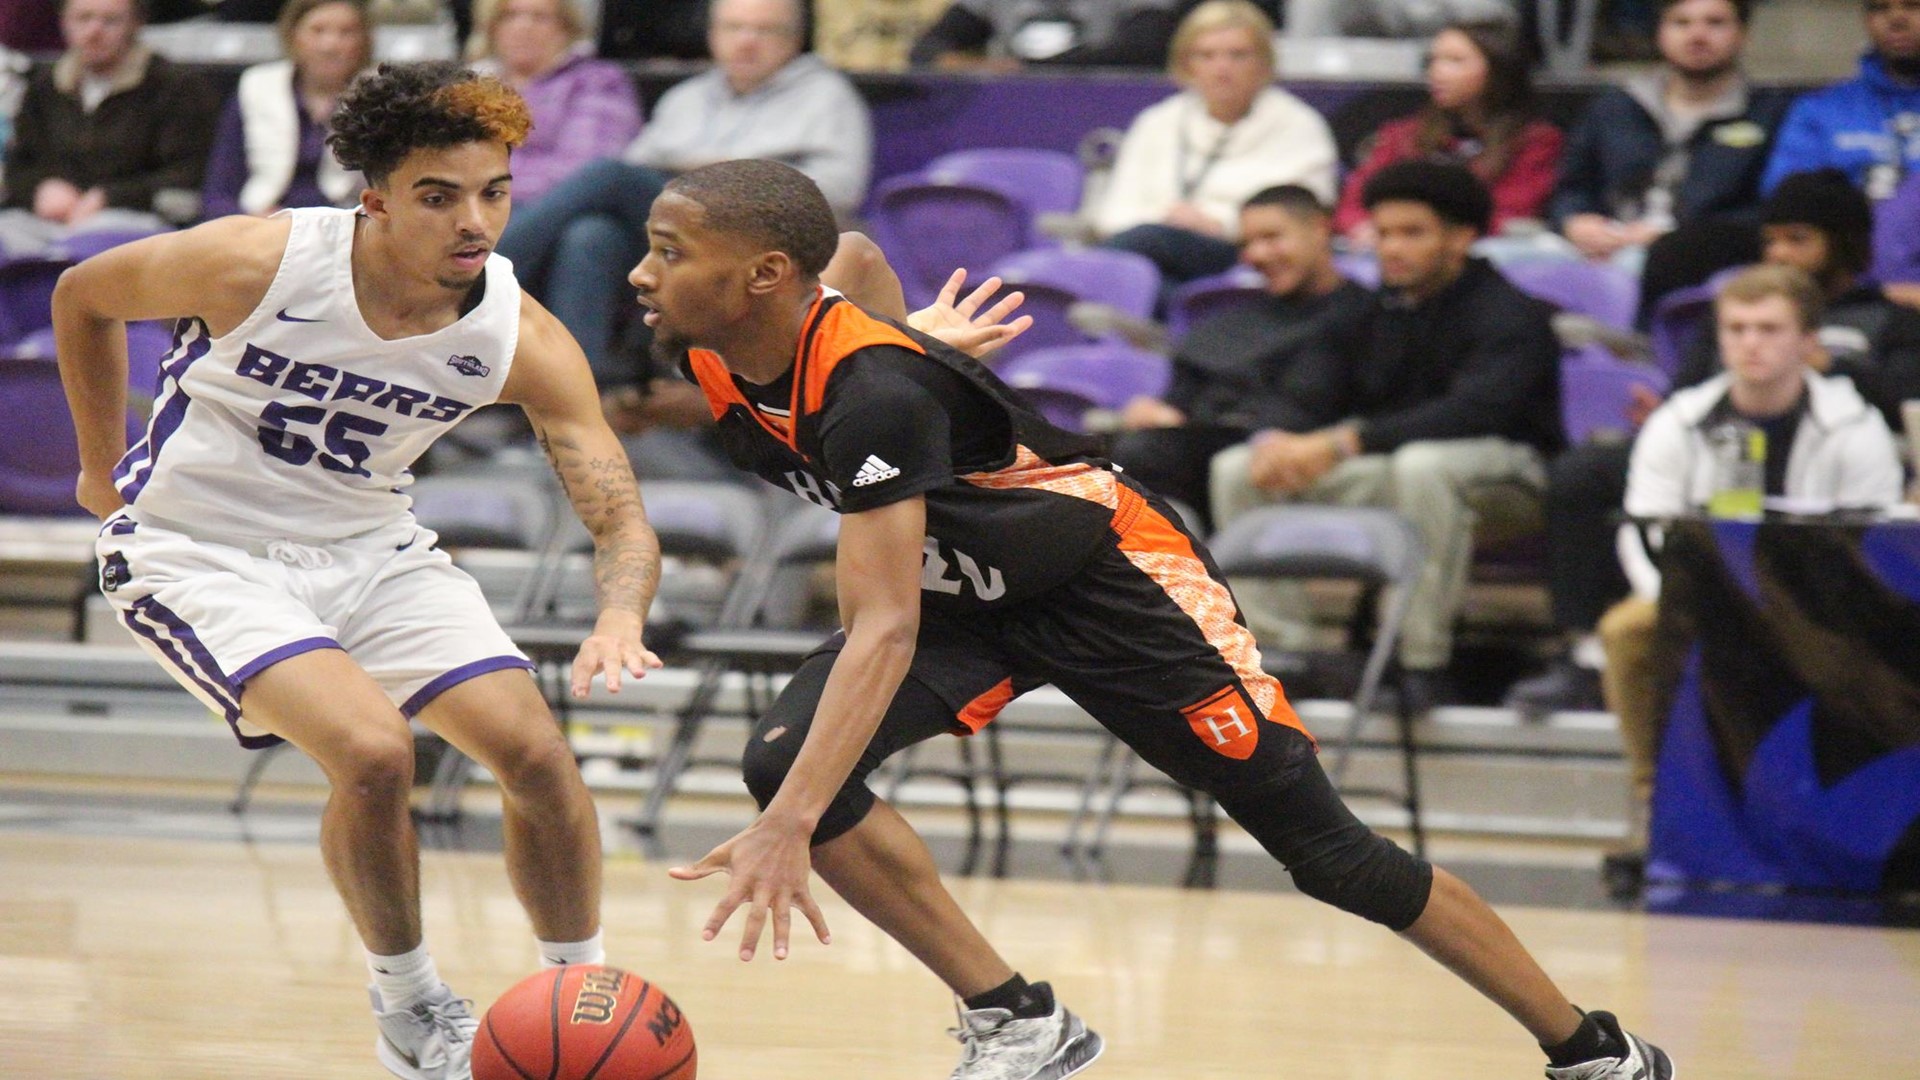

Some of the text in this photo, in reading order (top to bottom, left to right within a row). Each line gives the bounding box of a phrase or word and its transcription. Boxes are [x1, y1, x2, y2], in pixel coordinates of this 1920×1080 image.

[235, 342, 474, 423] BEARS
[853, 467, 901, 488] adidas
[1201, 705, 1252, 746] H
